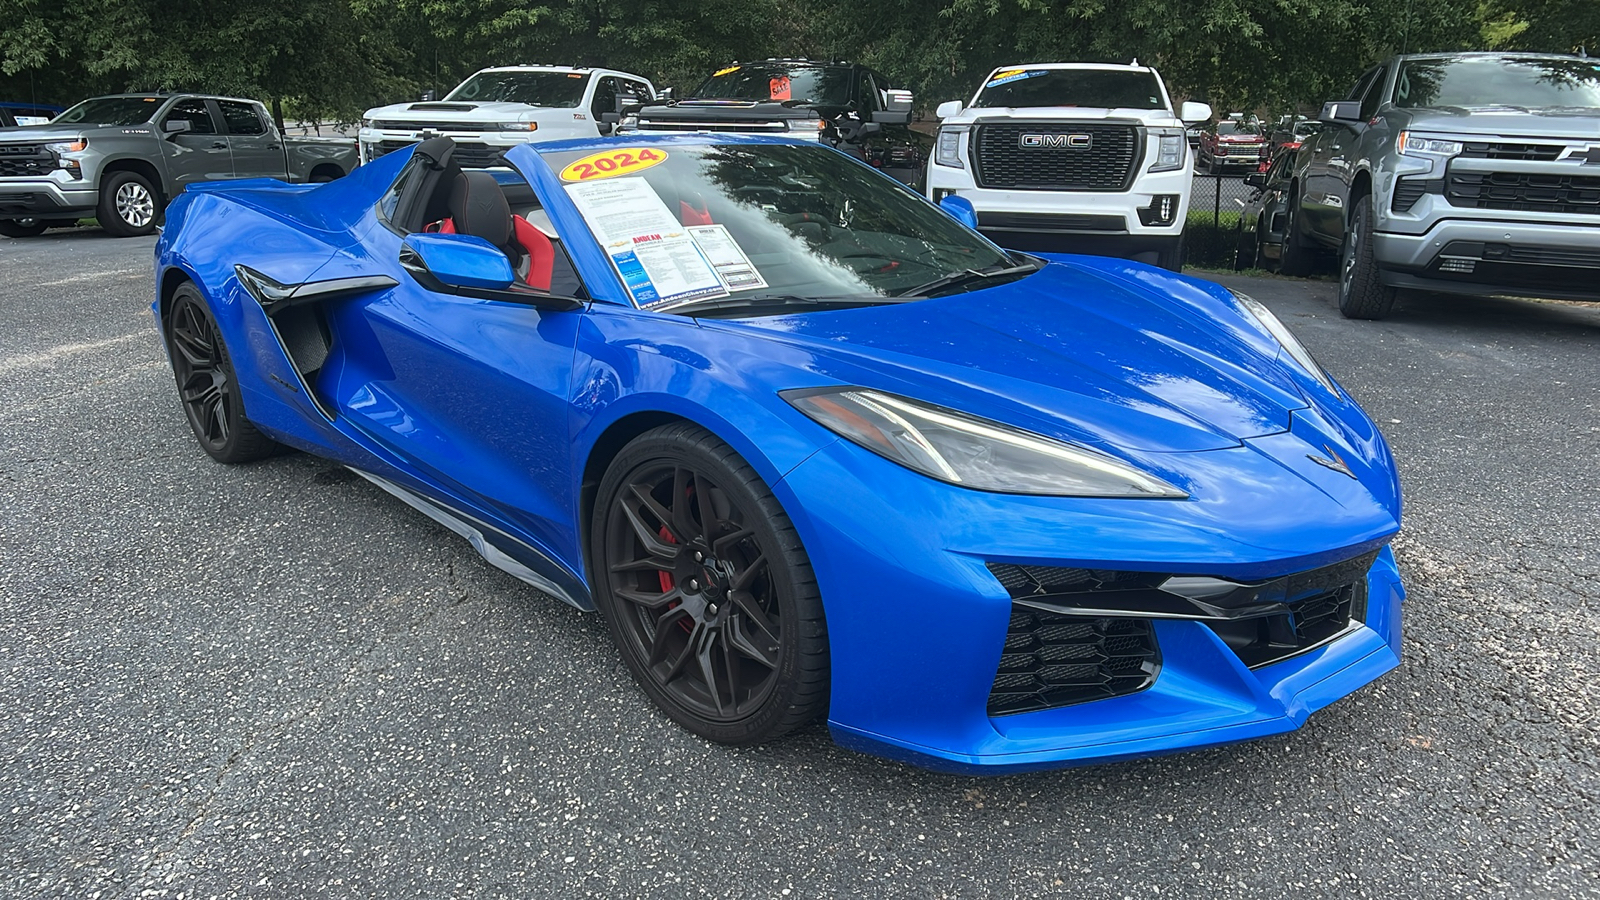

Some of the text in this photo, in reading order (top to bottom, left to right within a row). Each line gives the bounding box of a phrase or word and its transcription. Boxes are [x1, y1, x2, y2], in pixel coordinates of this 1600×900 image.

[772, 81, 789, 96] SALE
[1022, 134, 1089, 147] GMC
[573, 149, 660, 180] 2024
[632, 233, 662, 244] ANDEAN
[640, 286, 724, 309] www.AndeanChevy.com
